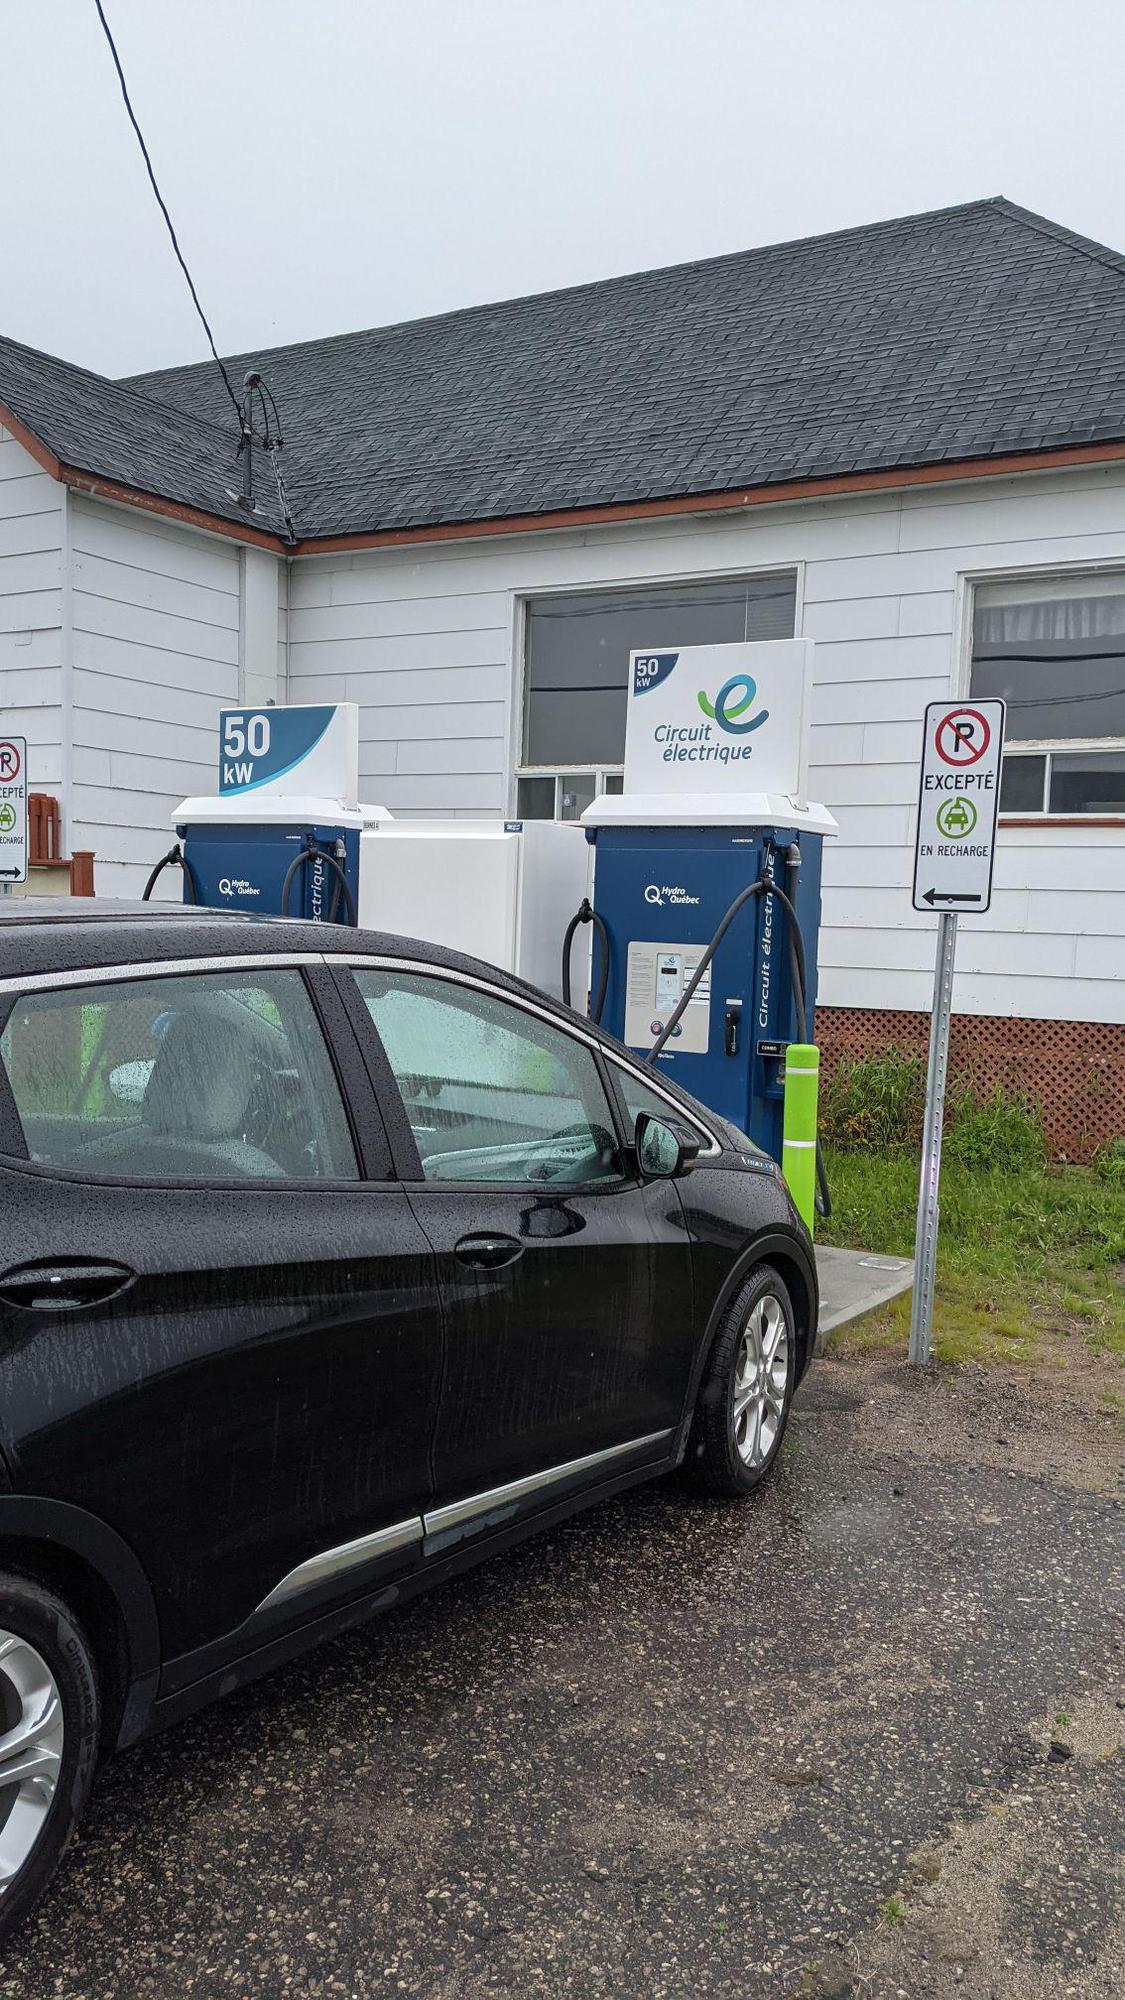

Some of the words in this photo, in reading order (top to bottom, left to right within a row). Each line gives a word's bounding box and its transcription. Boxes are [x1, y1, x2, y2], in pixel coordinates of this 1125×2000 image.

[637, 658, 659, 677] 50
[636, 678, 651, 688] kW
[223, 714, 271, 758] 50
[654, 723, 712, 743] Circuit
[662, 743, 753, 765] électrique
[223, 762, 254, 784] kW
[924, 770, 994, 790] EXCEPTÉ
[920, 845, 933, 857] EN
[937, 845, 989, 857] RECHARGE
[231, 879, 250, 888] Hydro
[237, 887, 260, 895] Québec
[311, 856, 325, 923] ectrique
[661, 886, 686, 896] Hydro
[670, 895, 700, 904] Québec
[762, 853, 776, 956] électriue
[759, 961, 770, 1028] Circuit
